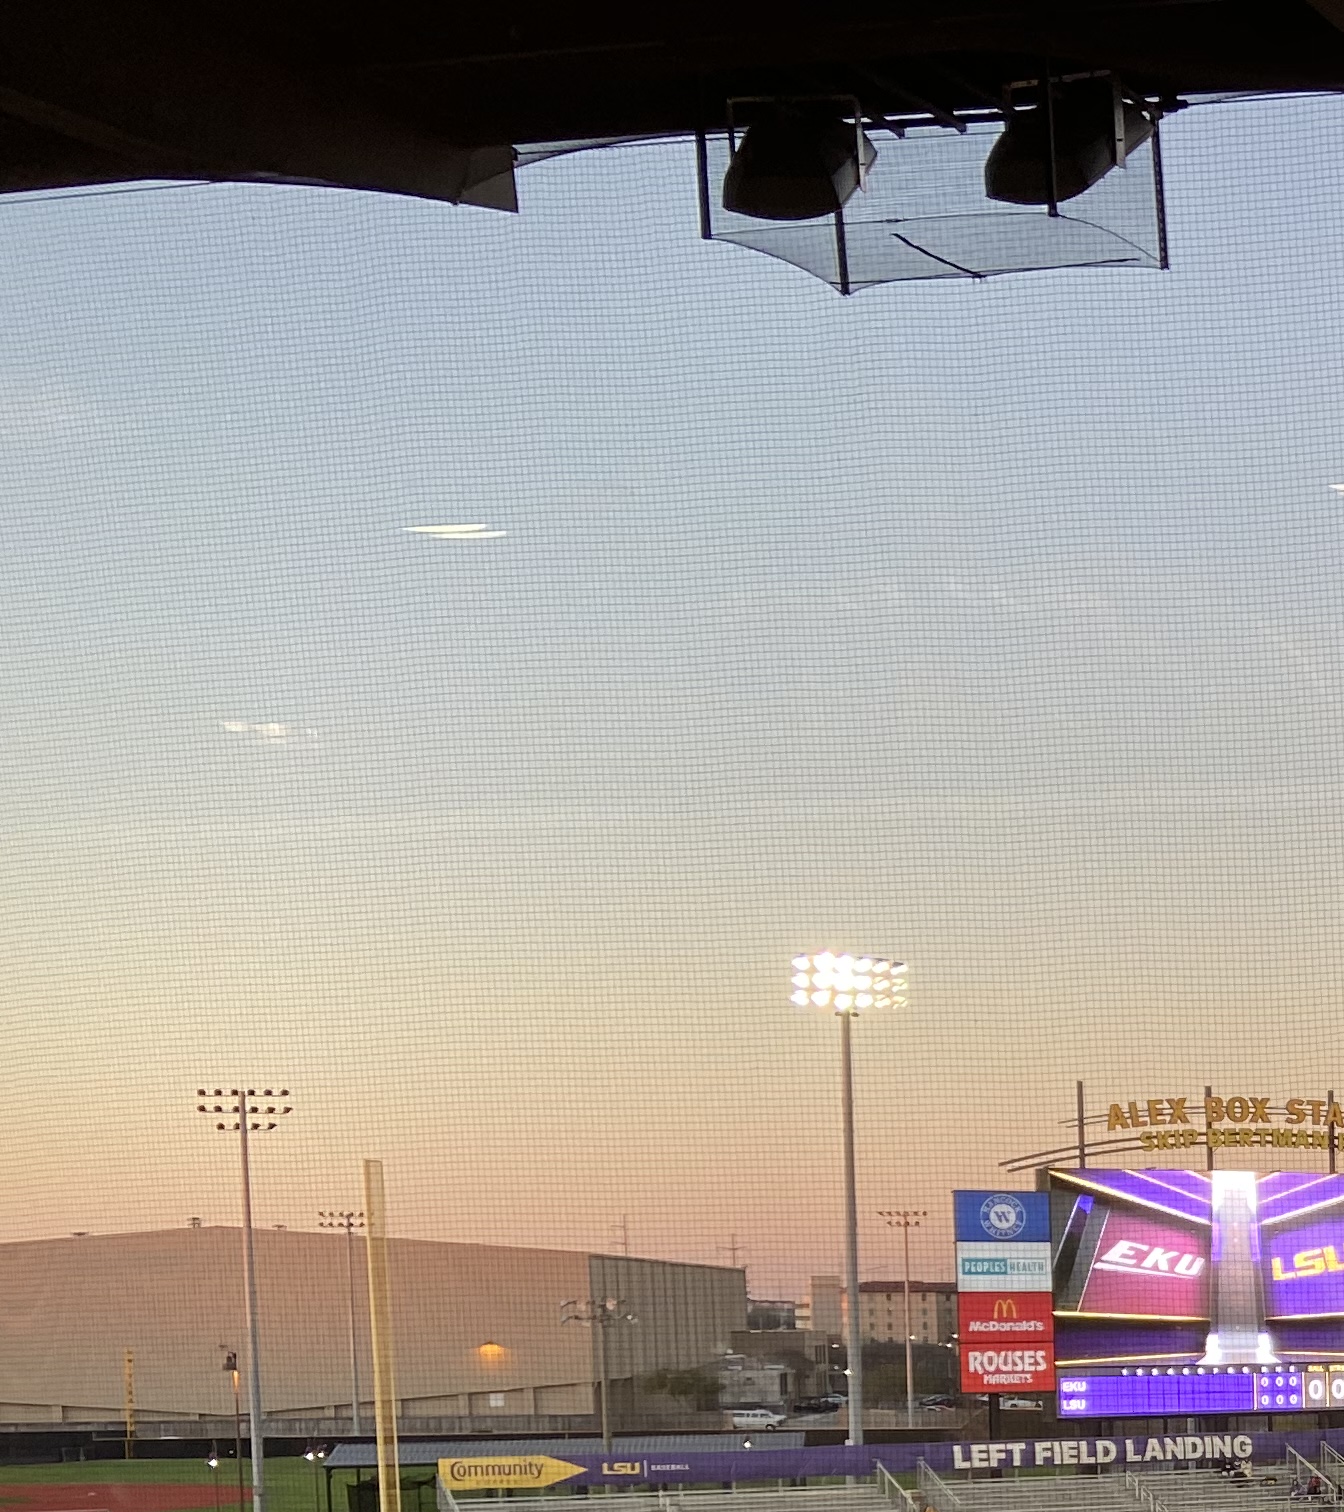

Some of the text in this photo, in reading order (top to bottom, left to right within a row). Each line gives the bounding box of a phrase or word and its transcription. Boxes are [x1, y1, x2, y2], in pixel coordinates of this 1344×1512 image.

[1107, 1097, 1190, 1131] ALEX
[1205, 1097, 1271, 1123] BOX
[1140, 1129, 1198, 1151] SKIP
[1207, 1128, 1330, 1149] BERTMAN
[964, 1260, 1045, 1275] PEOPLES HEALTH
[1101, 1239, 1205, 1276] EKU
[968, 1320, 1044, 1332] McDonald's
[968, 1350, 1047, 1374] ROUSES
[983, 1374, 1033, 1385] MARKETS
[1062, 1381, 1087, 1392] EKU
[1309, 1379, 1323, 1400] 0
[1062, 1400, 1086, 1410] LSU
[953, 1435, 1253, 1469] LEFT FIELD LANDING
[450, 1459, 544, 1481] Community
[602, 1461, 641, 1476] LSU
